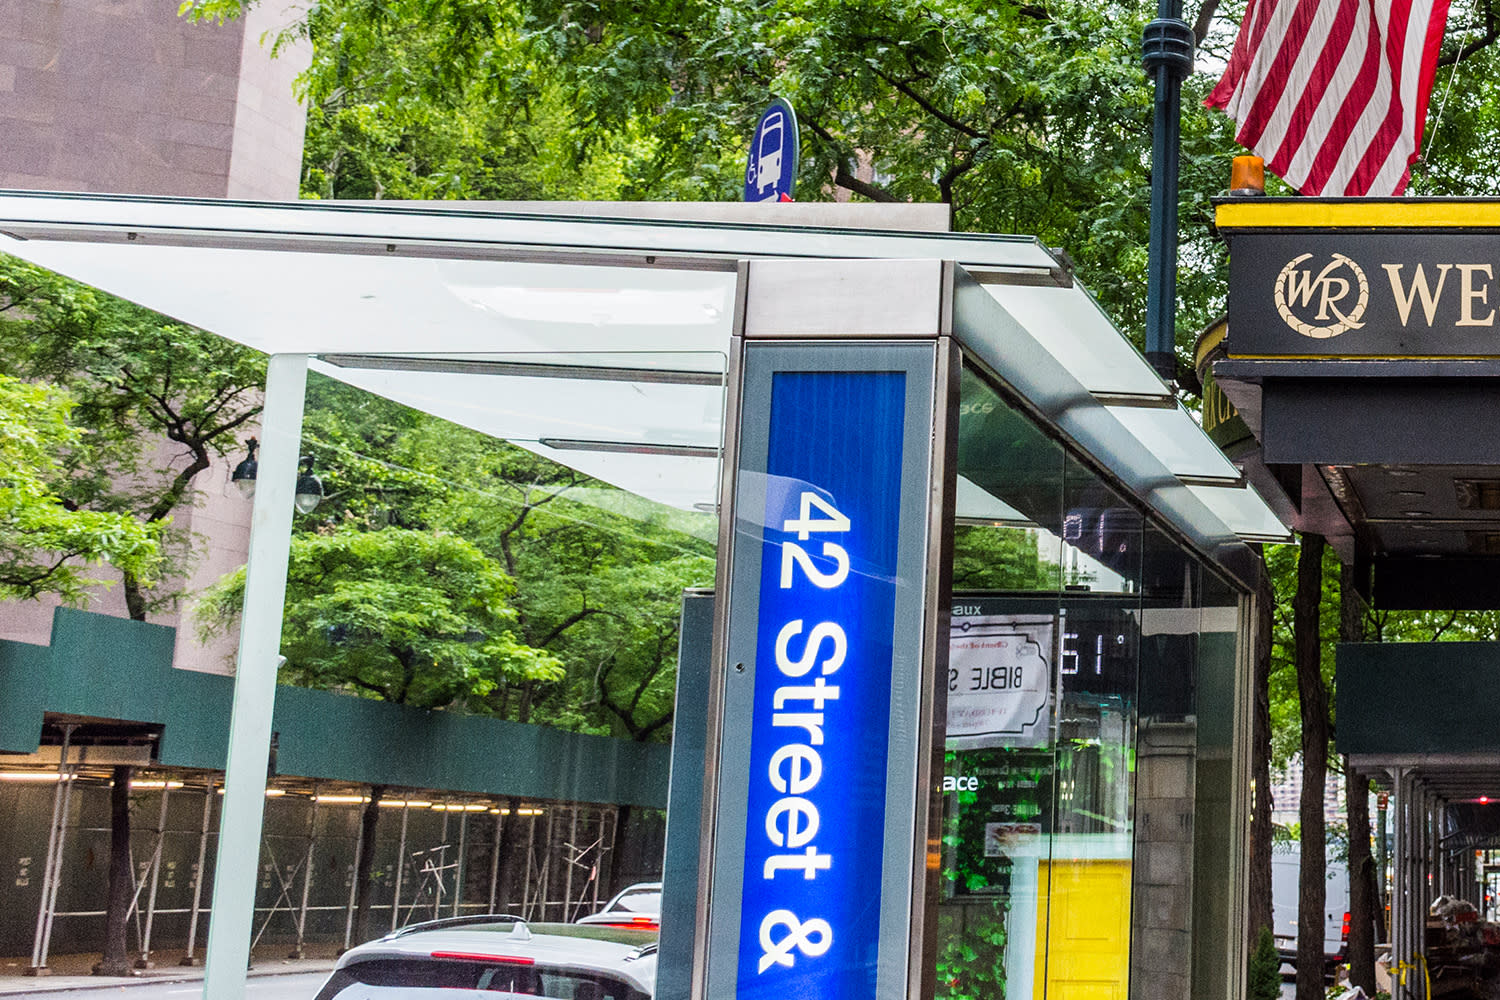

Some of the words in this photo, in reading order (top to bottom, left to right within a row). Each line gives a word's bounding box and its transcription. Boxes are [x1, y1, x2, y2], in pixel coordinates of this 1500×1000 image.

[779, 491, 851, 590] 42
[763, 618, 848, 881] Street
[758, 908, 833, 976] &
